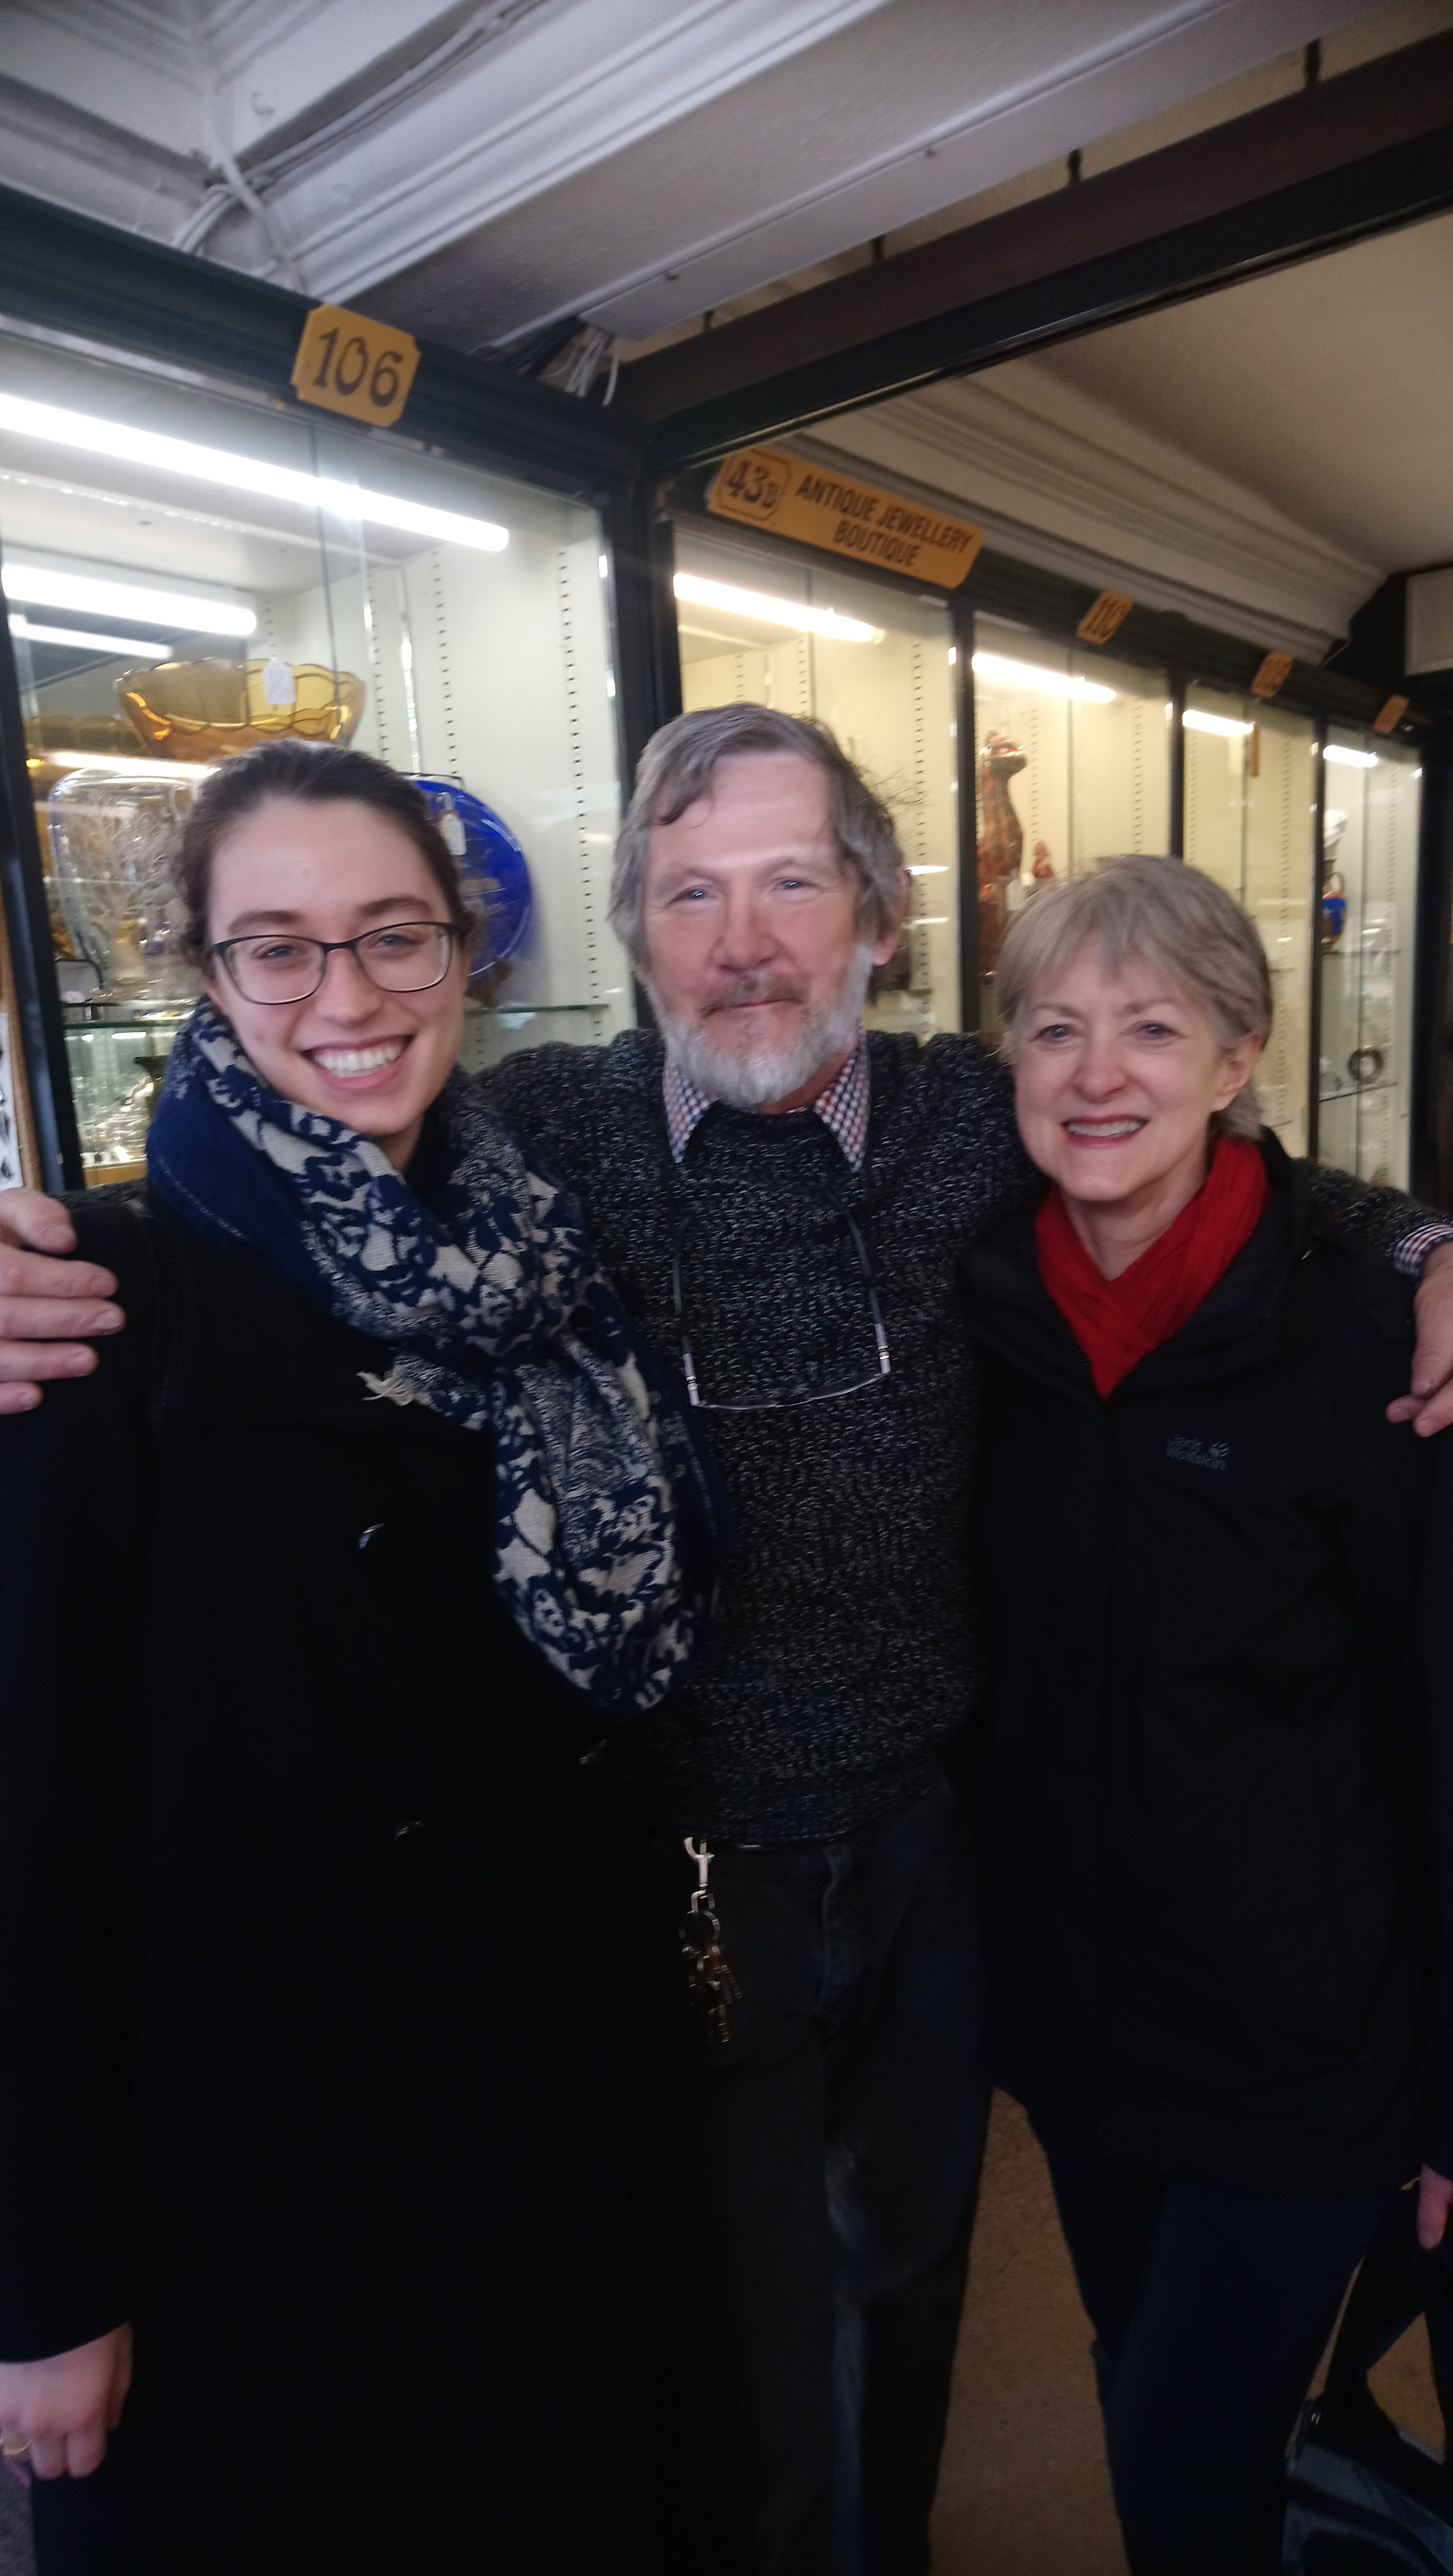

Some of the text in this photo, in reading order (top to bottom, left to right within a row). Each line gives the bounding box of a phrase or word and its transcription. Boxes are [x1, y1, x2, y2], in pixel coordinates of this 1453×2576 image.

[314, 327, 403, 407] 106
[796, 475, 973, 552] ANTIQUE JEWELLERY
[832, 521, 920, 566] BOUTIQUE
